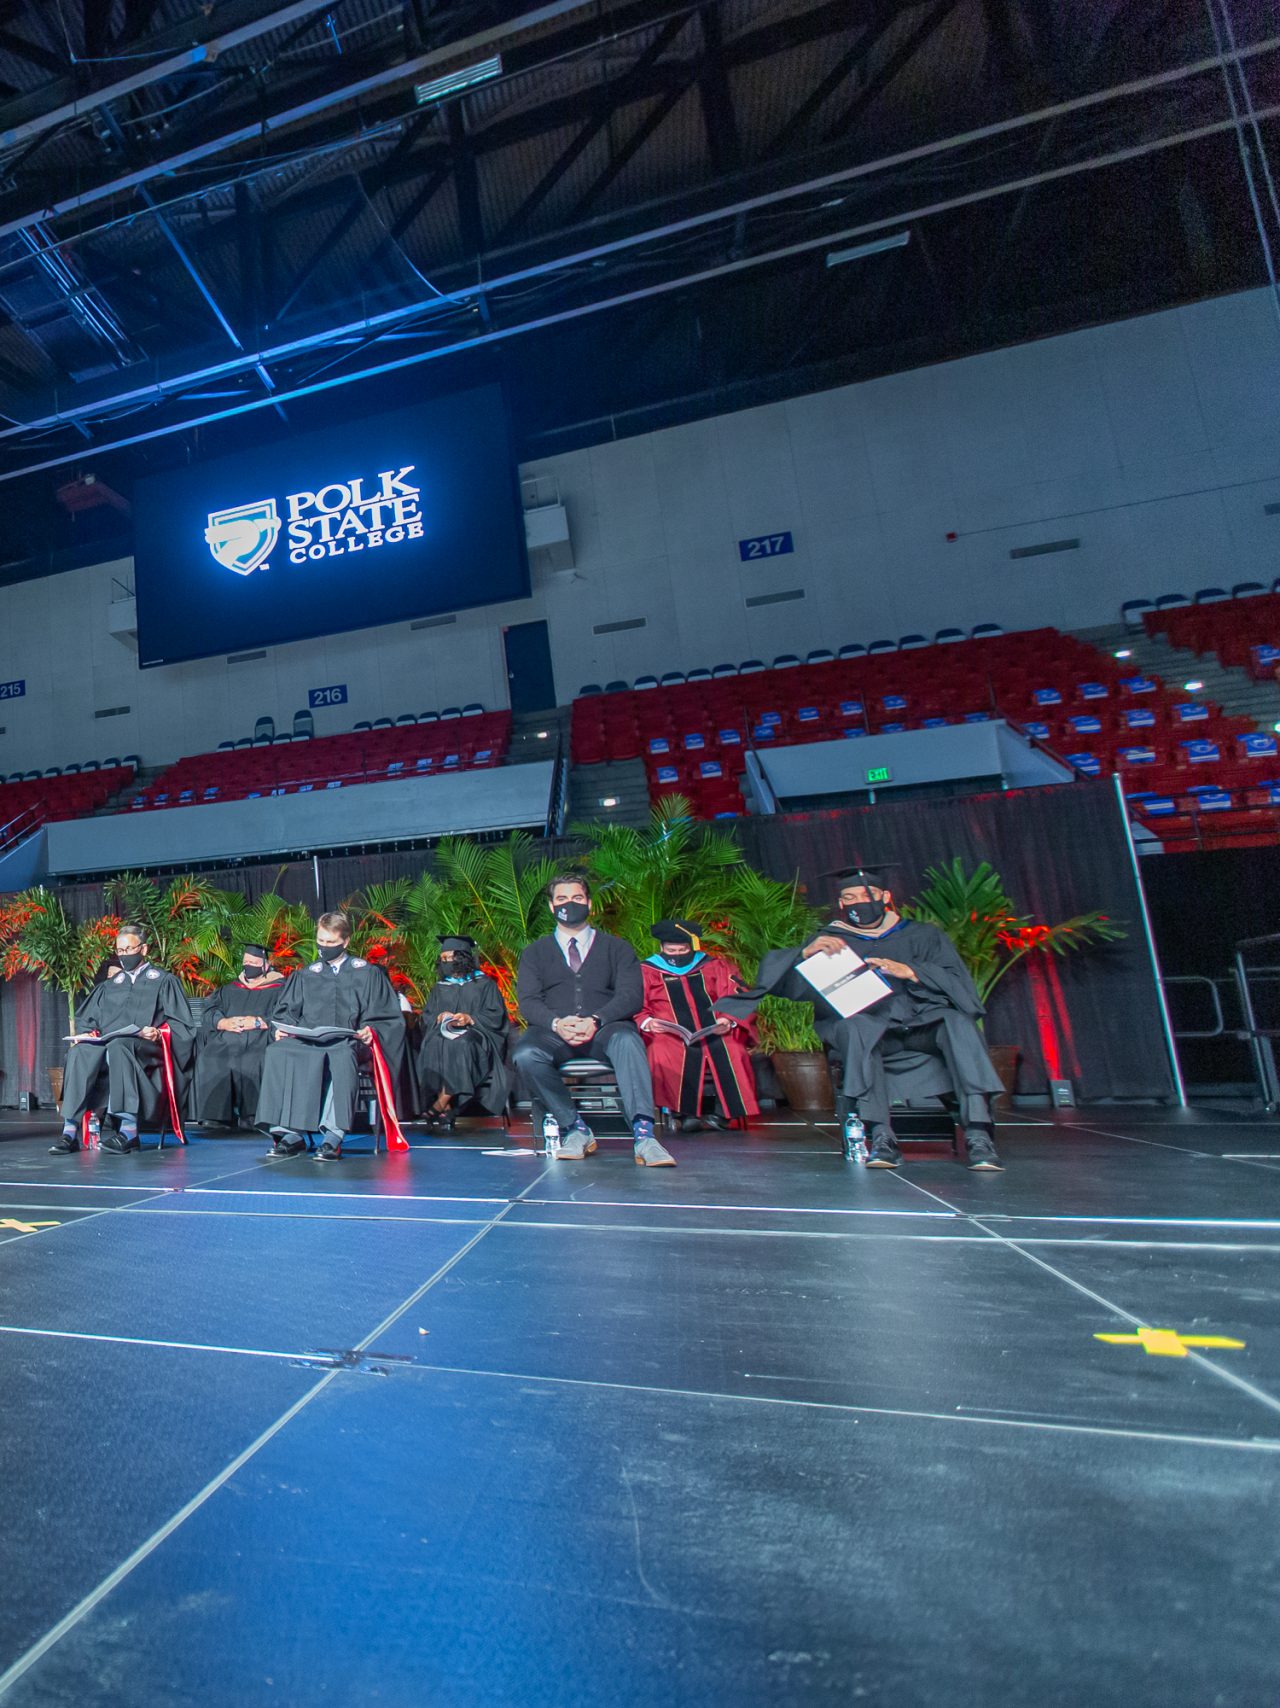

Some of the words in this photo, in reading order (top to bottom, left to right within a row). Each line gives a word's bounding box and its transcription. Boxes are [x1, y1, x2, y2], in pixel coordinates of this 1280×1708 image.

[286, 465, 420, 522] POLK
[288, 493, 422, 550] STATE
[289, 522, 424, 564] COLLEGE
[748, 536, 785, 558] 217
[0, 683, 21, 698] 215
[314, 688, 342, 705] 216
[868, 767, 888, 781] EXIT
